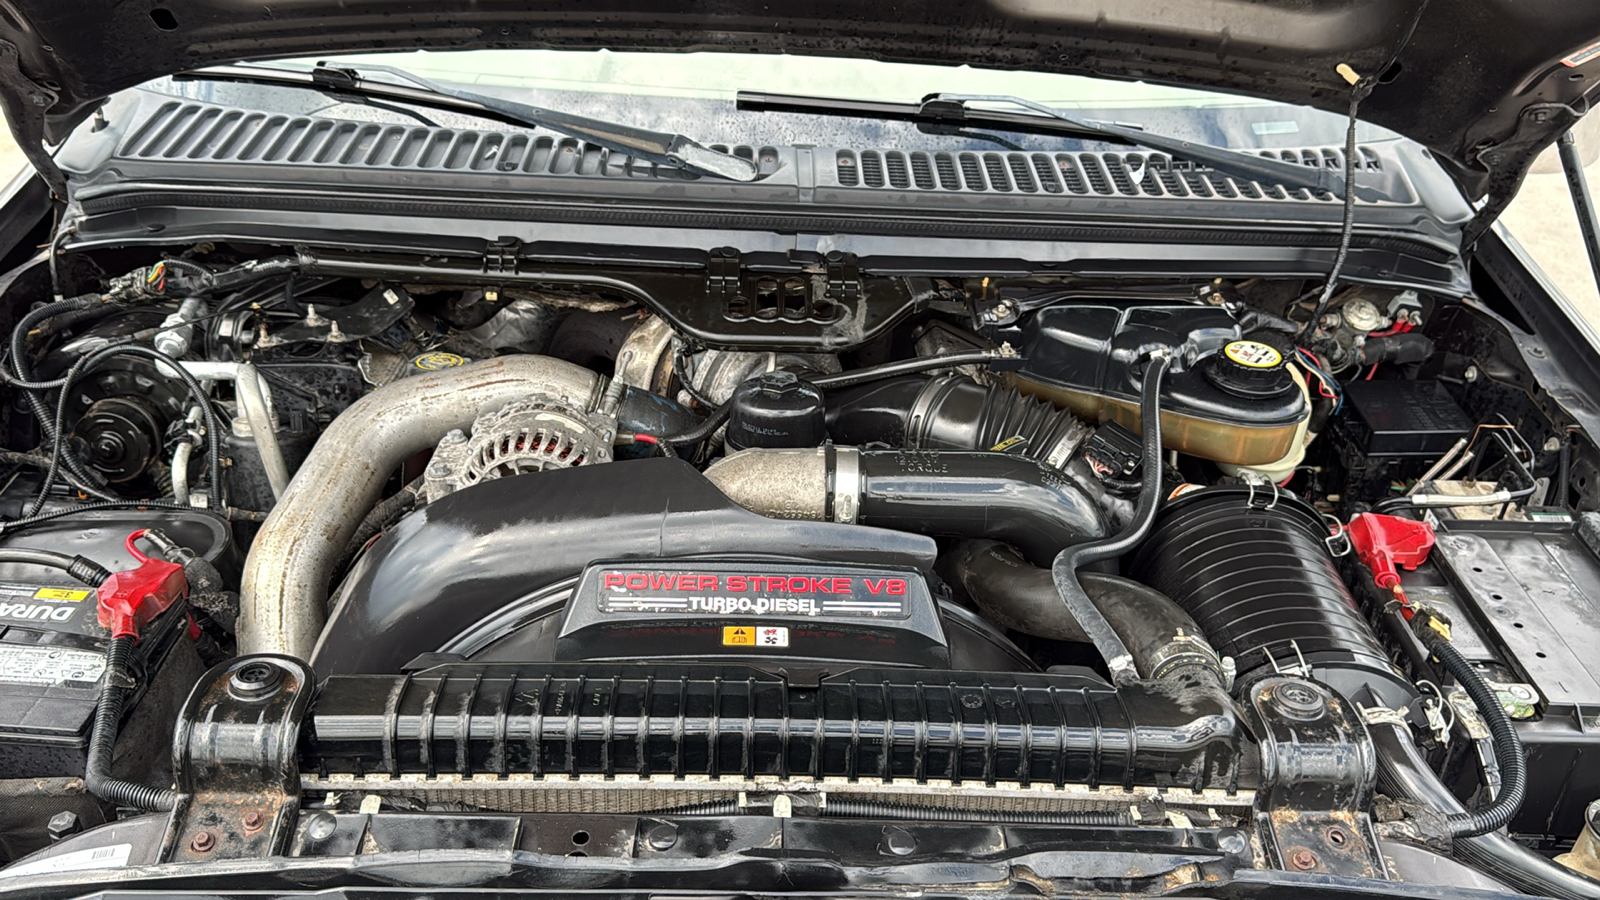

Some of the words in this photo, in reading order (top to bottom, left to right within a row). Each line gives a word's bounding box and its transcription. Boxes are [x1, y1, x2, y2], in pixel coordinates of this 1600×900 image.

[899, 462, 949, 473] TORQUE
[604, 573, 719, 591] POWER
[726, 575, 852, 594] STROKE
[863, 578, 907, 595] V8
[0, 602, 76, 621] DURA
[688, 596, 752, 613] TURBO
[756, 597, 821, 613] DIESEL
